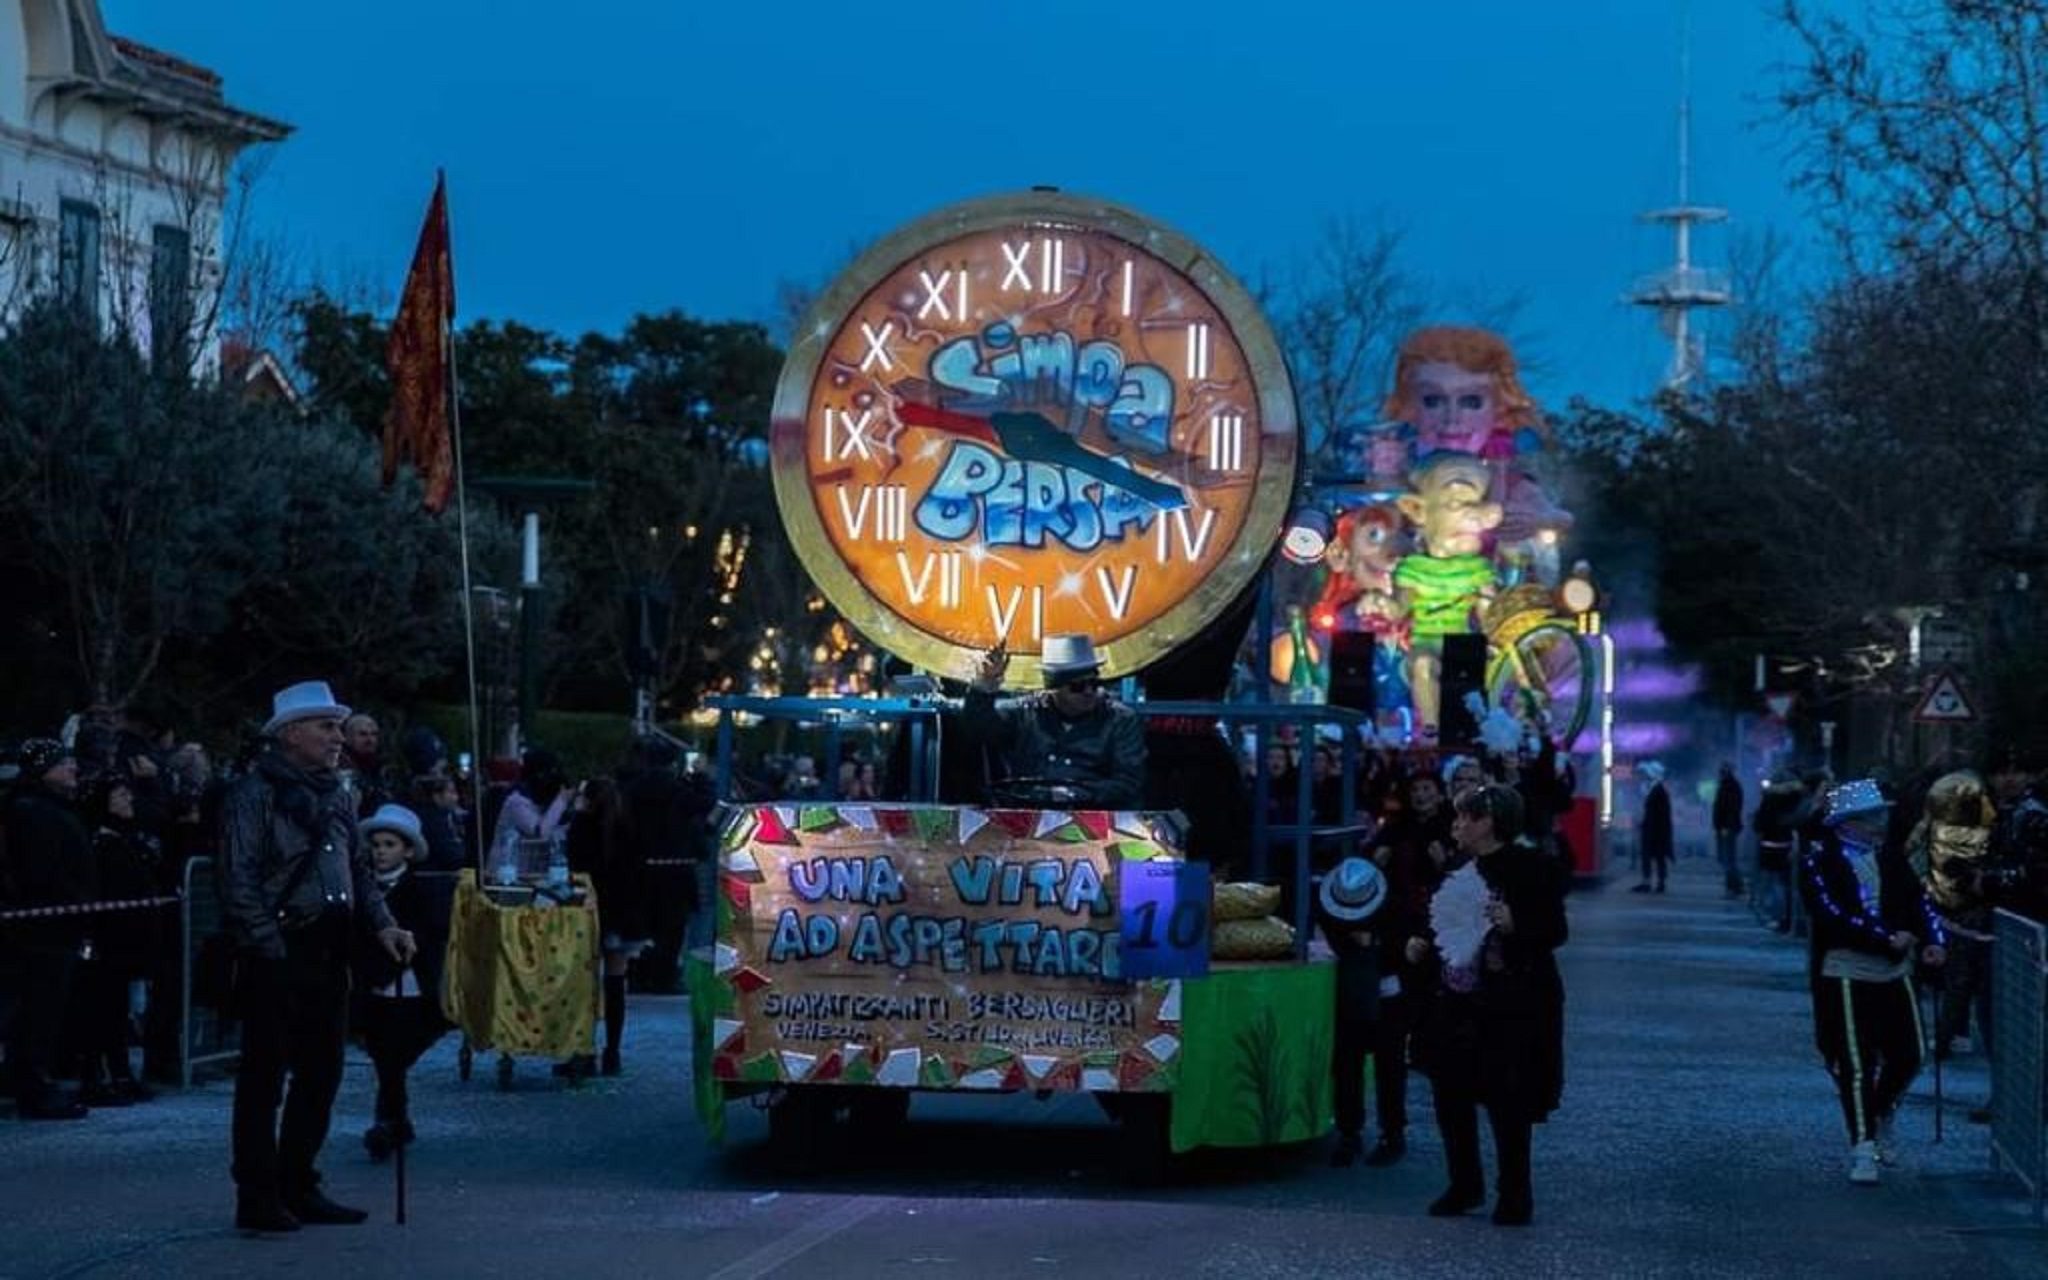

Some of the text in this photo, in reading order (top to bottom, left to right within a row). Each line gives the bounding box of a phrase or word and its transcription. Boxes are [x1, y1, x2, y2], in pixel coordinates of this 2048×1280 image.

[1001, 239, 1064, 293] XII
[1121, 260, 1134, 316] I
[918, 268, 967, 321] XI
[860, 321, 893, 372] X
[1186, 323, 1208, 380] II
[823, 407, 873, 462] IX
[1210, 415, 1242, 471] III
[837, 486, 906, 540] VIII
[1156, 508, 1214, 563] IV
[896, 551, 962, 608] VII
[1097, 565, 1137, 621] V
[986, 585, 1043, 640] VI
[788, 854, 1114, 916] UNA VITA
[767, 908, 840, 964] AD
[1127, 900, 1206, 949] 10
[967, 993, 1136, 1029] BERSAGLIERI
